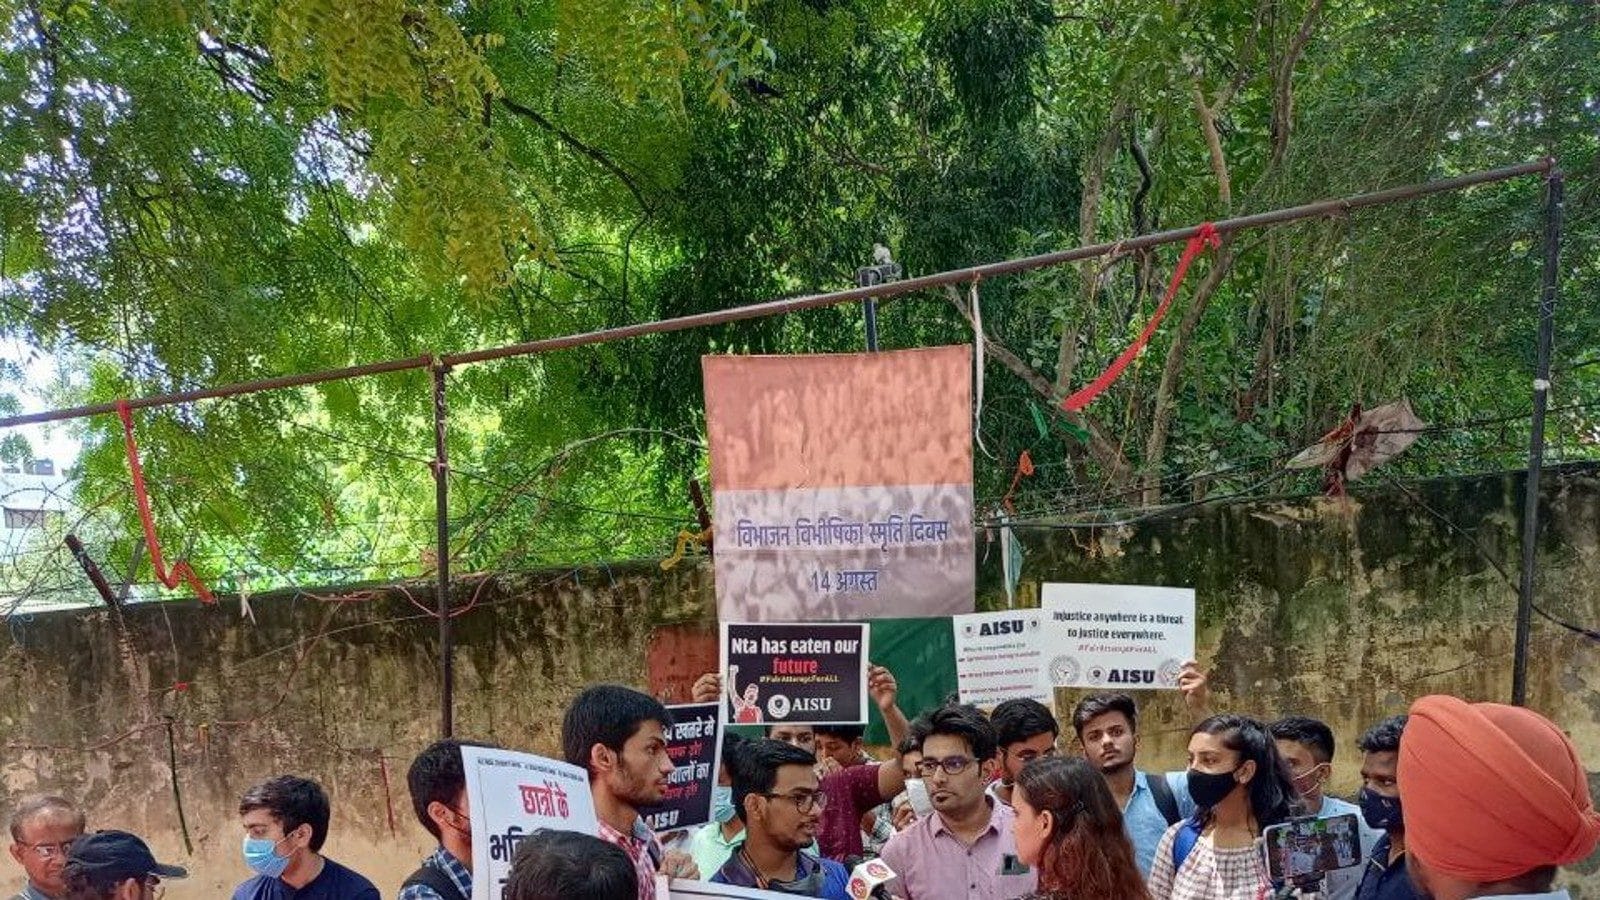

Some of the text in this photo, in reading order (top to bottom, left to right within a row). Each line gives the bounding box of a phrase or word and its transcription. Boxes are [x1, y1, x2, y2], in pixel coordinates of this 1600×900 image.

[737, 514, 949, 552] विभाजन विभीषिका स्मृति दिवस
[810, 570, 878, 593] 14 अगस्त
[1093, 613, 1137, 624] anywhere
[1139, 612, 1148, 622] is
[1149, 615, 1155, 623] a
[1156, 614, 1184, 624] threat
[979, 620, 1025, 636] AISU
[1067, 628, 1167, 641] to justice everywhere.
[731, 637, 859, 654] Nta has eaten our
[773, 657, 818, 674] future
[1107, 669, 1156, 684] AISU
[792, 698, 832, 711] AISU
[696, 763, 711, 780] का
[518, 778, 570, 819] छात्रों के
